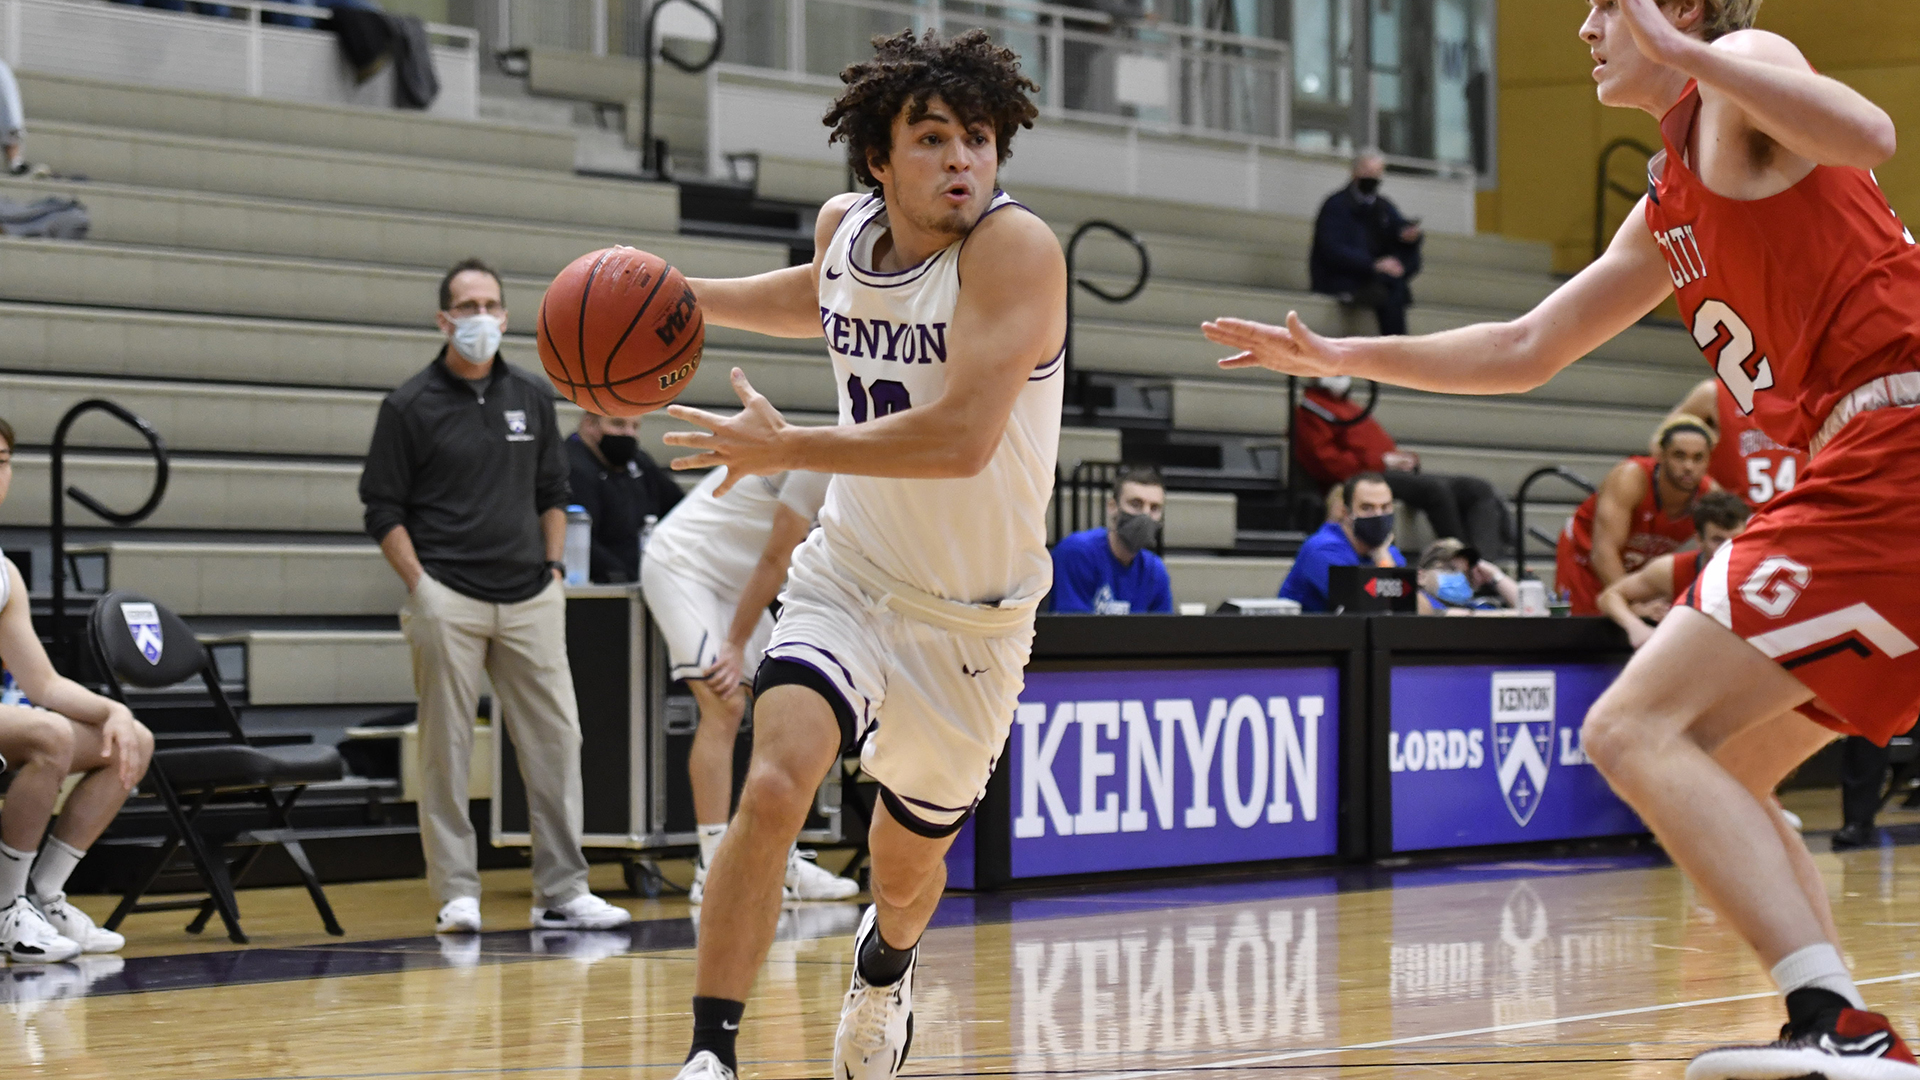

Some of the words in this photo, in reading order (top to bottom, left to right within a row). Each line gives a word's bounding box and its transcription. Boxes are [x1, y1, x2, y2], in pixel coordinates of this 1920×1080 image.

[655, 288, 698, 347] NCAA
[821, 306, 947, 364] KENYON
[1746, 455, 1797, 503] 54
[1738, 554, 1812, 619] G
[1499, 686, 1550, 712] KENYON
[1014, 694, 1325, 839] KENYON
[1389, 728, 1485, 772] LORDS
